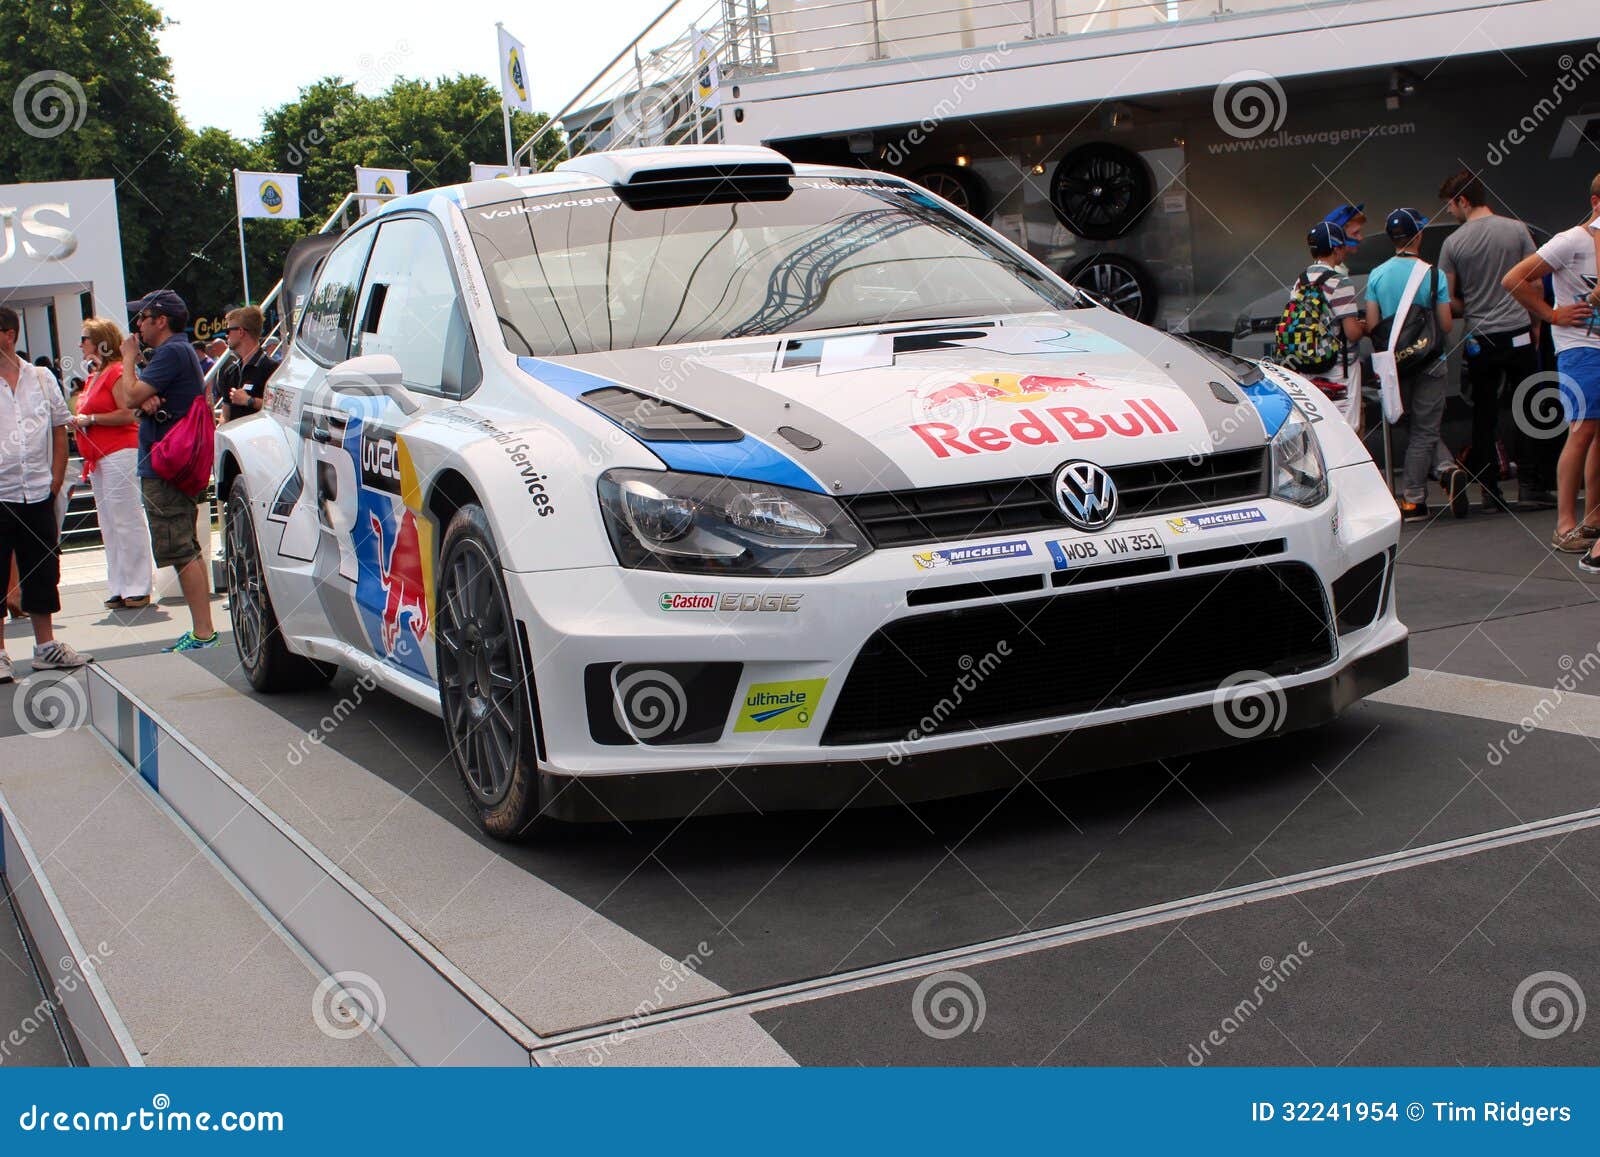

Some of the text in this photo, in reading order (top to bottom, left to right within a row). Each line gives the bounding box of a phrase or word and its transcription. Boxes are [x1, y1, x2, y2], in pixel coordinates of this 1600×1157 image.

[1208, 121, 1416, 155] www.volkswagen-r.com
[480, 194, 621, 221] Volkswagen
[909, 398, 1179, 458] Red Bull
[505, 444, 555, 517] Services
[1197, 508, 1262, 527] MICHELIN
[950, 542, 1028, 561] MICHELIN
[1062, 540, 1099, 559] WOB
[1104, 537, 1129, 555] VW
[1132, 534, 1162, 552] 351
[672, 592, 804, 612] Castrol EDGE
[747, 690, 806, 706] ultimate
